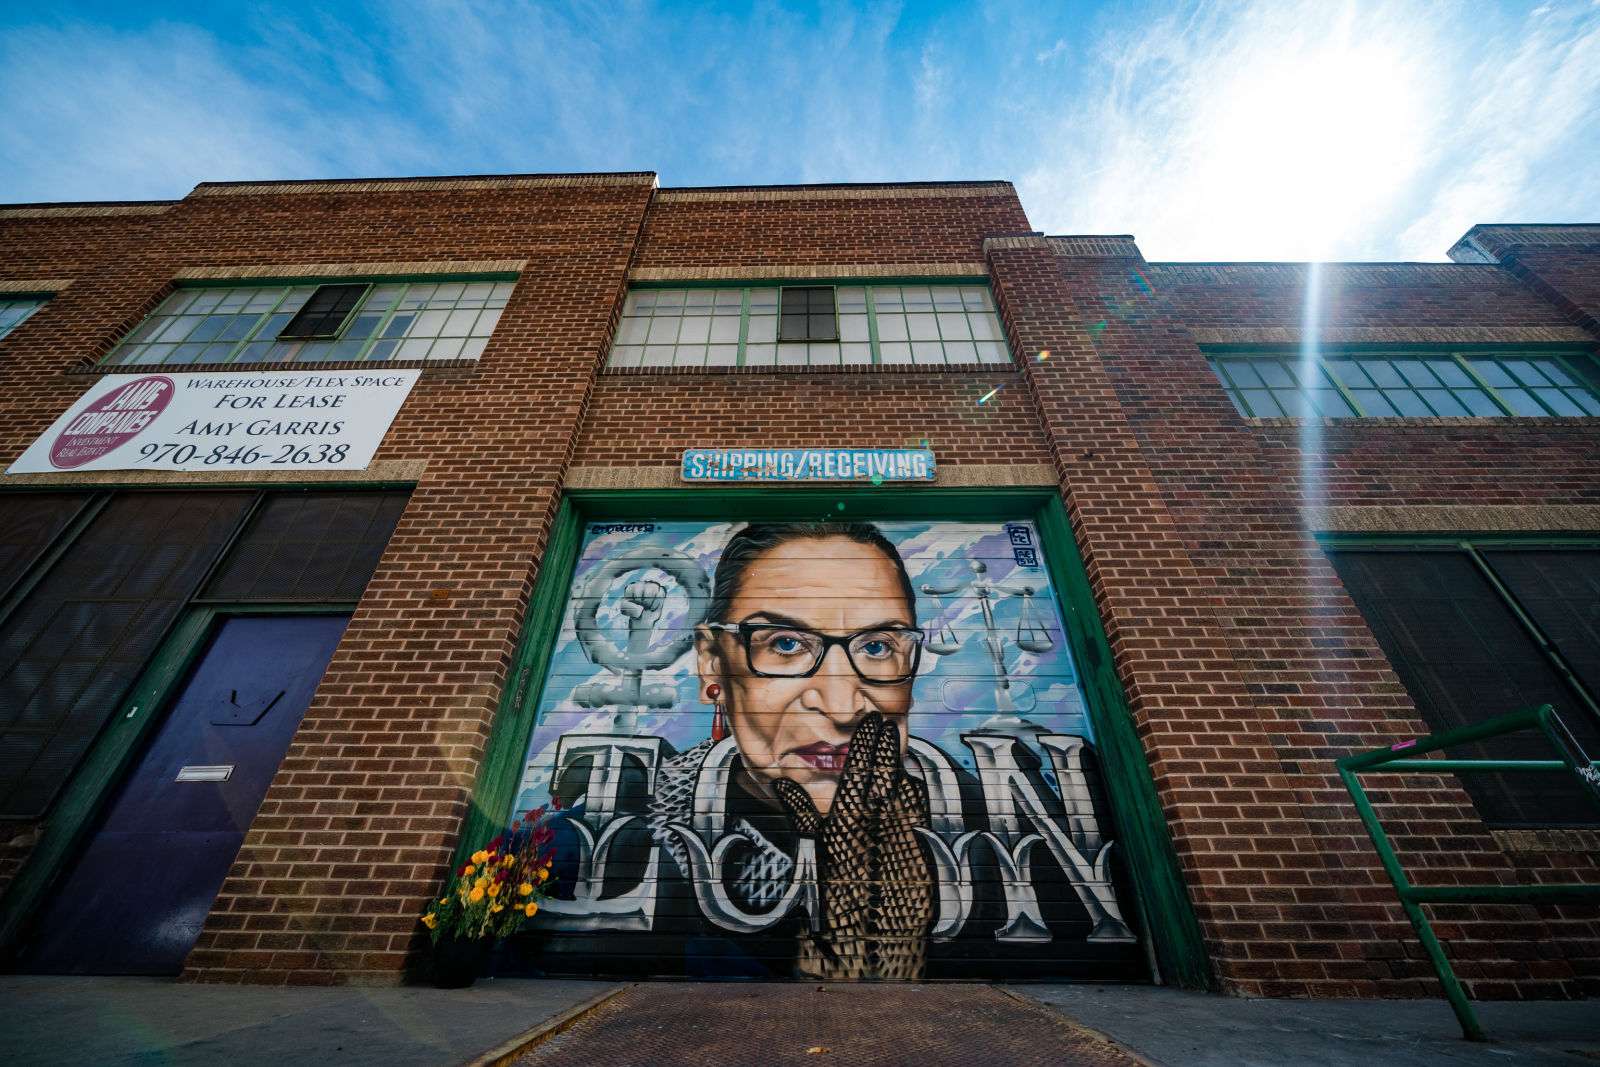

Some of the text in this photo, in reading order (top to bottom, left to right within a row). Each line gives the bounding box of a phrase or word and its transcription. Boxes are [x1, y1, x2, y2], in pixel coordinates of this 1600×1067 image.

[186, 376, 406, 390] WAREHOUSE/FLEX SPACE
[101, 380, 169, 411] JAMIS
[213, 394, 347, 409] FOR LEASE
[64, 410, 159, 435] COMPANIES
[175, 419, 345, 436] AMY GARRIS
[65, 437, 120, 447] INVESTMENT
[56, 446, 108, 458] REAL ESTATE
[133, 443, 351, 465] 970-846-2638
[691, 451, 928, 478] SHIPPING/RECEIVING
